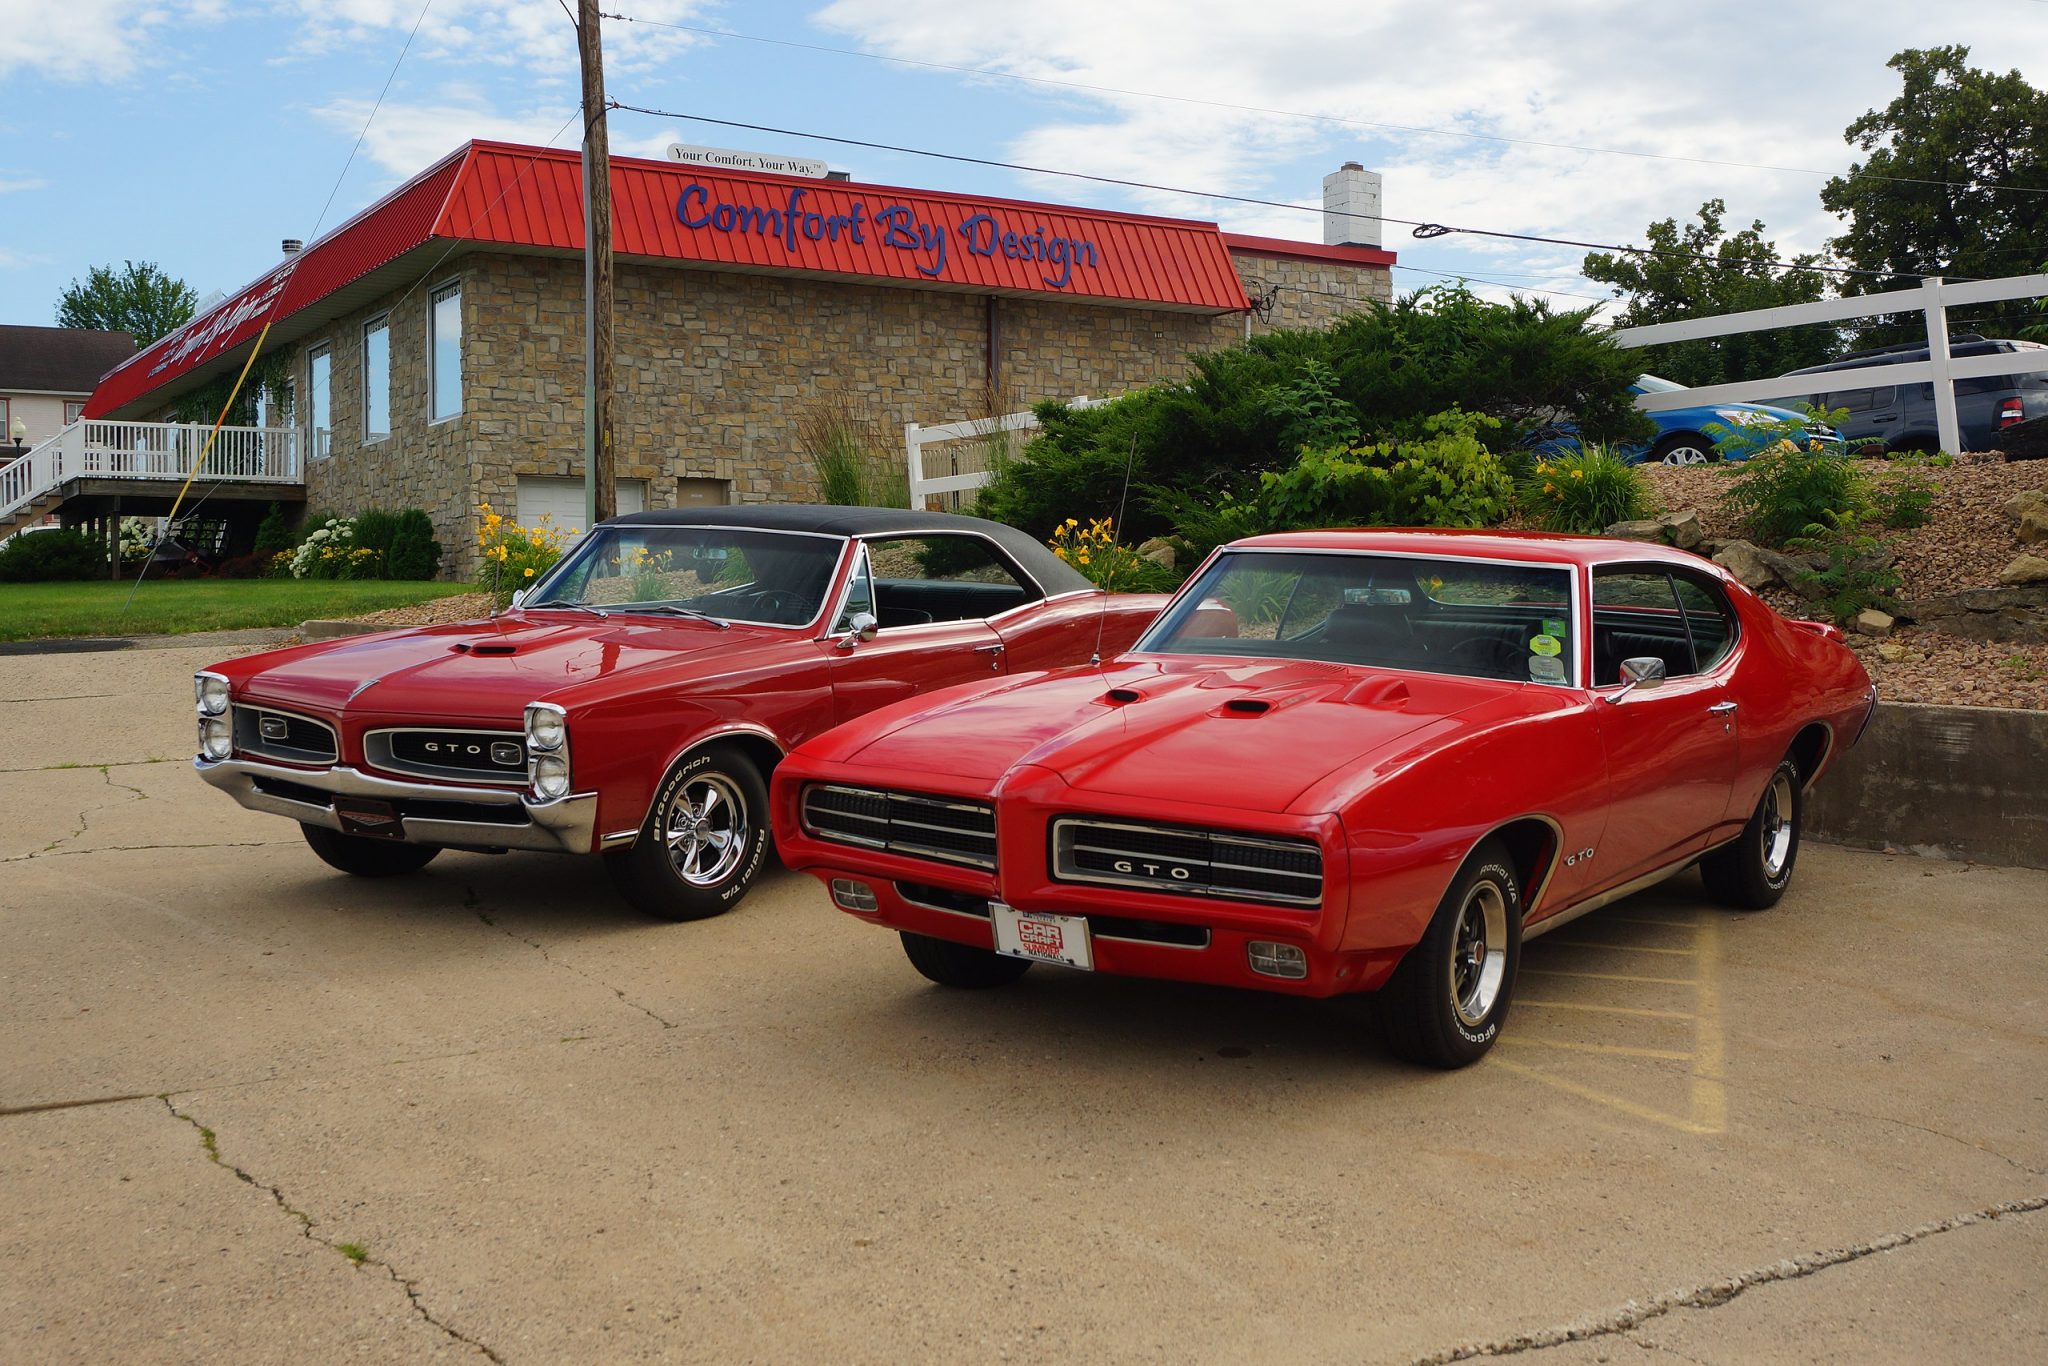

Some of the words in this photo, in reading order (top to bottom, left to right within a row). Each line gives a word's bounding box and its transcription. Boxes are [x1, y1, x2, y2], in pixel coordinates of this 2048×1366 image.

[675, 147, 703, 161] Your
[705, 151, 755, 168] Comfort.
[758, 157, 785, 171] Your
[677, 183, 866, 252] Comfort
[875, 204, 946, 275] By
[959, 213, 1098, 288] Design
[424, 741, 481, 755] GTO
[653, 755, 711, 842] BFGoodrich
[741, 828, 765, 885] Radial
[1566, 847, 1594, 867] GTO
[1113, 860, 1190, 880] GTO
[1480, 863, 1509, 880] Radial
[720, 884, 741, 901] T/A
[1019, 920, 1061, 939] CAR
[1020, 933, 1062, 947] CRAFT
[1023, 941, 1061, 956] SUMMER
[1449, 992, 1496, 1043] BFGood
